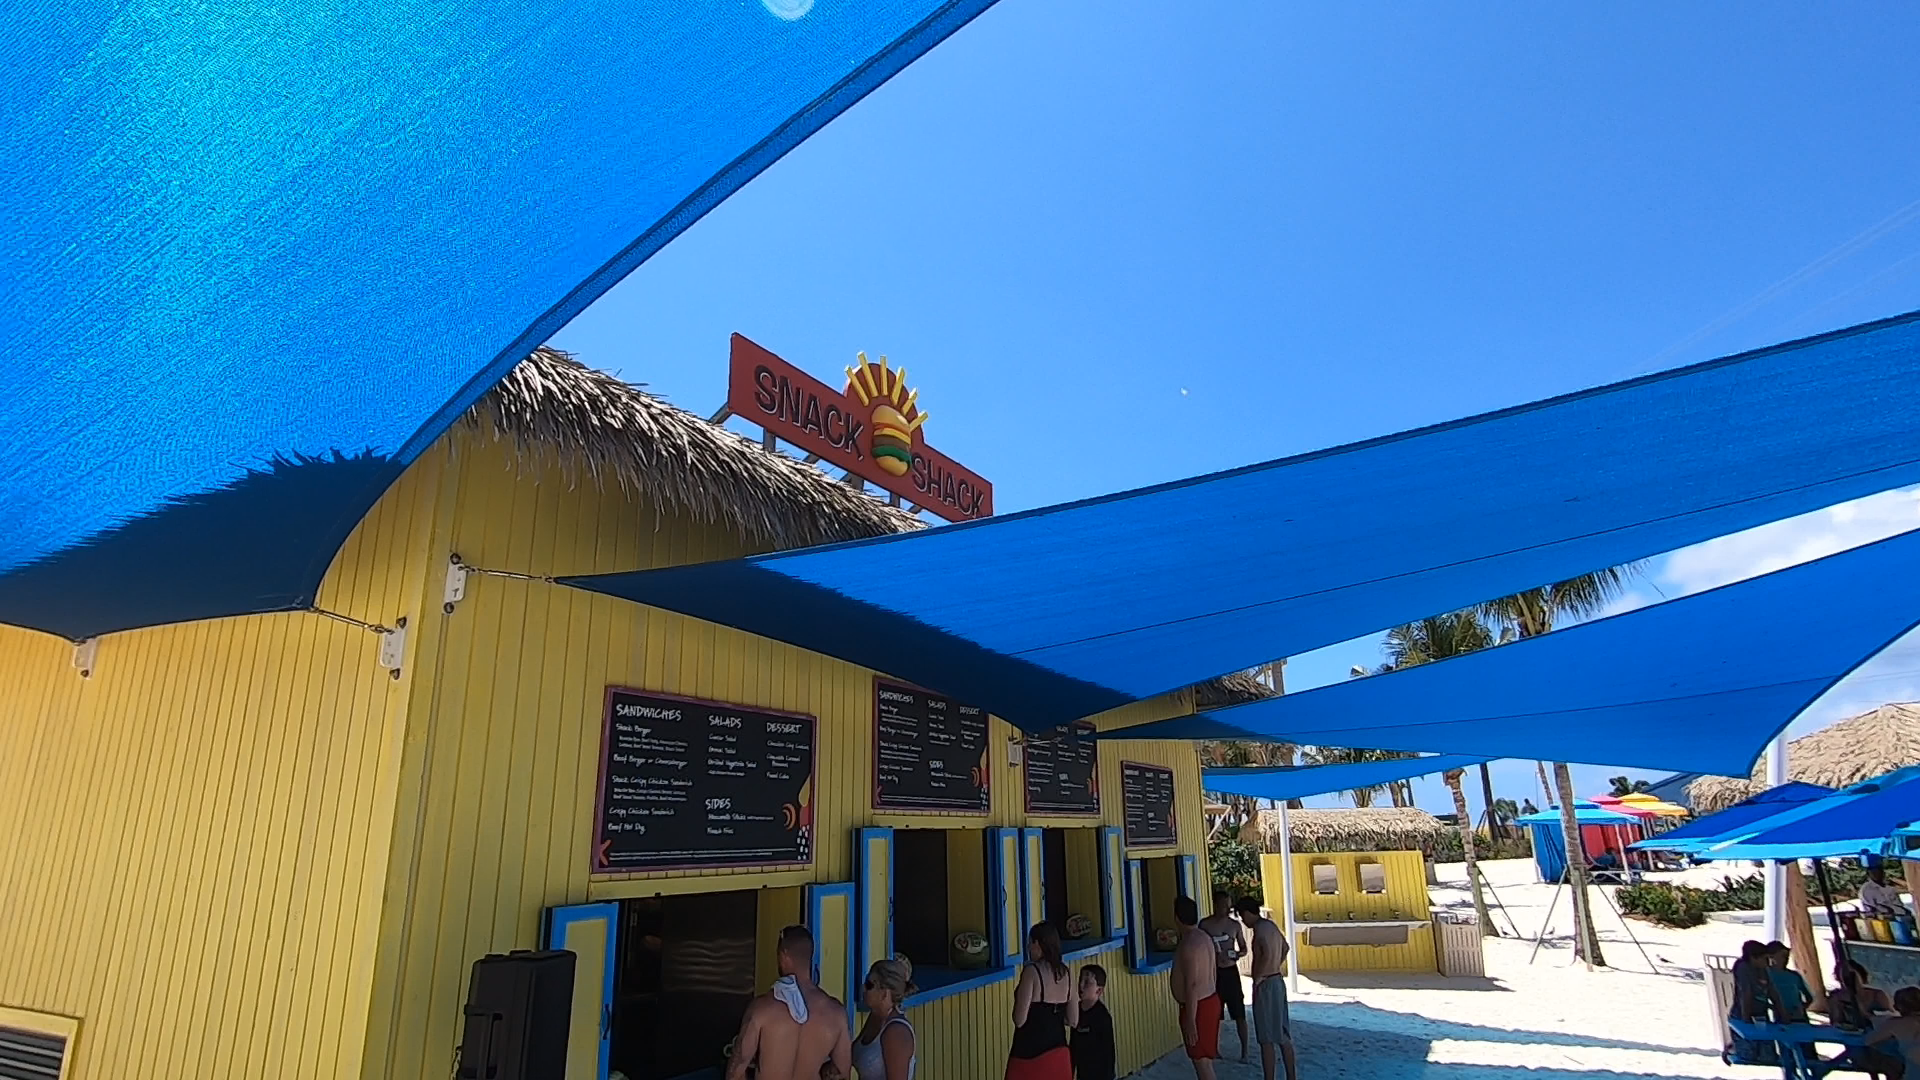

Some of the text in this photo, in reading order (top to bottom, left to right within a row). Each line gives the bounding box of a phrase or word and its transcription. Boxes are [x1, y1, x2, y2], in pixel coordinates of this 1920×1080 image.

[754, 365, 865, 461] SNACK
[911, 452, 984, 518] SHACK
[616, 704, 682, 721] SANDWICHES
[708, 715, 742, 729] SALADS
[766, 722, 802, 734] DESSERT
[705, 798, 732, 810] SIDES
[634, 823, 646, 835] Dog
